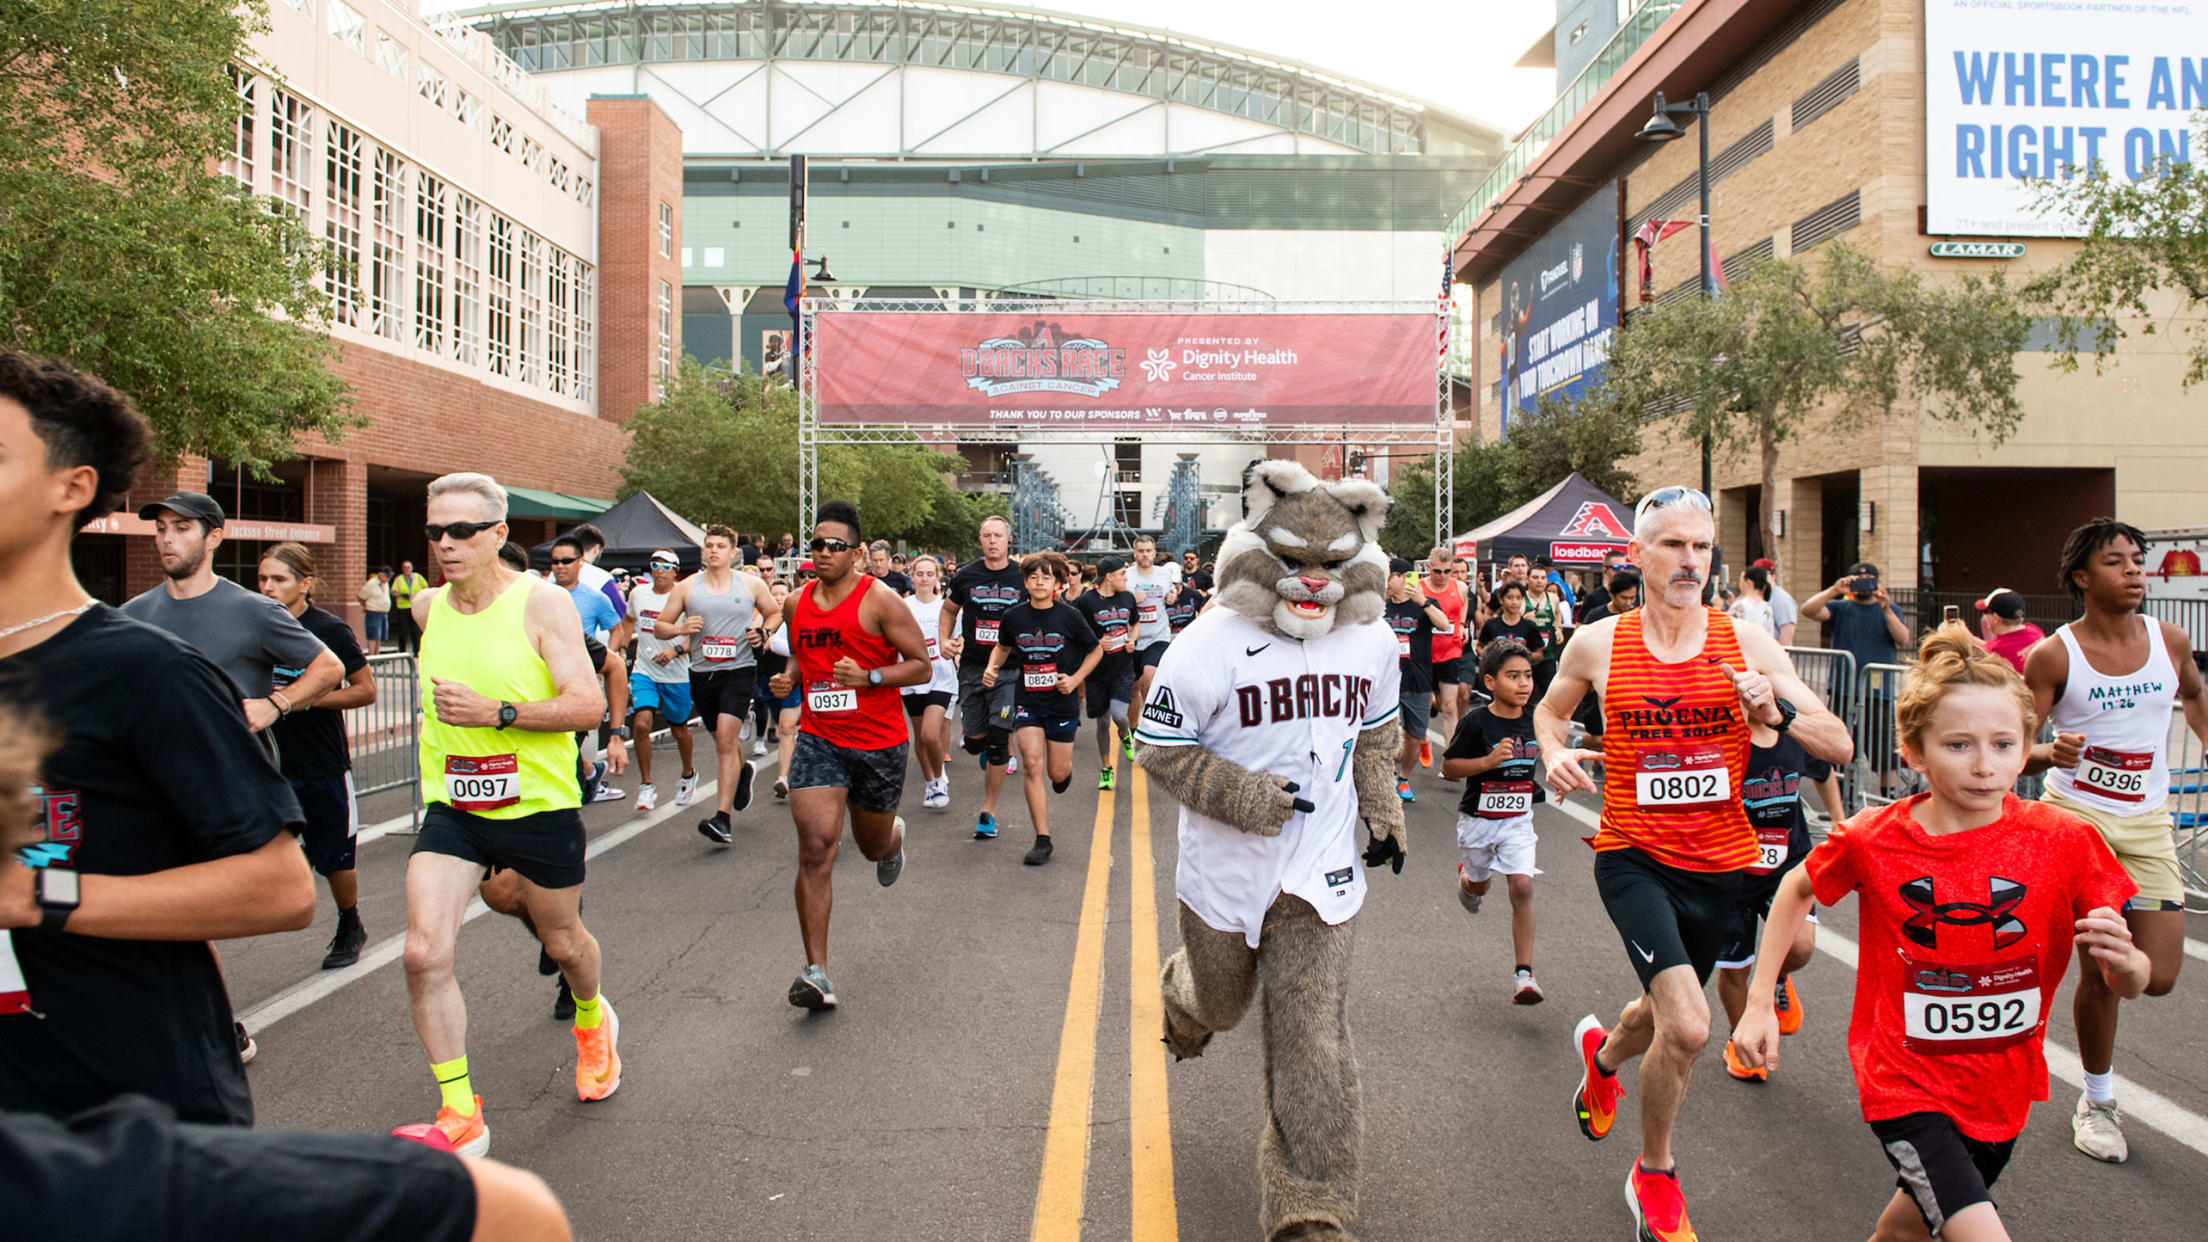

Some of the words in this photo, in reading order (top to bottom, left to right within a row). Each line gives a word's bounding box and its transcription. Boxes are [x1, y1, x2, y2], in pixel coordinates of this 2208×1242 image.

[2017, 1, 2083, 12] SPORTSBOOK
[2086, 4, 2132, 13] PARTNER
[2135, 5, 2148, 13] OF
[2152, 5, 2169, 14] THE
[1953, 50, 2130, 109] WHERE
[2147, 56, 2208, 111] AN
[1956, 123, 2107, 181] RIGHT
[2124, 127, 2190, 182] ON
[1955, 218, 1976, 230] 21+
[1981, 219, 2002, 231] and
[2006, 221, 2044, 233] present
[1939, 242, 2018, 255] LAMAR
[1529, 327, 1550, 365] START
[1550, 306, 1586, 350] WORKING
[1586, 298, 1599, 334] ON
[1177, 337, 1241, 345] PRESENTED
[1245, 337, 1260, 345] BY
[1060, 348, 1126, 378] RACE
[1182, 349, 1241, 369] Dignity
[1244, 348, 1298, 365] Health
[1182, 371, 1216, 381] Cancer
[1217, 371, 1257, 381] Institute
[1520, 366, 1537, 400] YOUR
[1538, 342, 1583, 391] TOUCHDOWN
[992, 381, 1043, 394] AGAINST
[1047, 381, 1097, 395] CANCER
[990, 410, 1024, 419] THANK
[1027, 410, 1047, 419] YOU
[1050, 410, 1062, 419] TO
[1064, 410, 1086, 419] OUR
[1088, 410, 1141, 420] SPONSORS
[230, 524, 261, 538] Jackson
[264, 525, 288, 539] Street
[290, 527, 321, 541] Entrance
[1555, 546, 1612, 557] losdbac
[978, 629, 1000, 640] 027
[706, 647, 732, 656] 0778
[1028, 674, 1054, 686] 0824
[814, 693, 848, 709] 0937
[1144, 706, 1181, 726] AVNET
[1620, 706, 1736, 731] PHOENIX
[1630, 728, 1673, 740] FREE
[1681, 724, 1729, 738] SOLES
[1335, 737, 1354, 783] 1
[2088, 766, 2142, 791] 0396
[454, 778, 508, 797] 0097
[1650, 775, 1718, 800] 0802
[1486, 795, 1525, 809] 0829
[1924, 998, 2025, 1035] 0592
